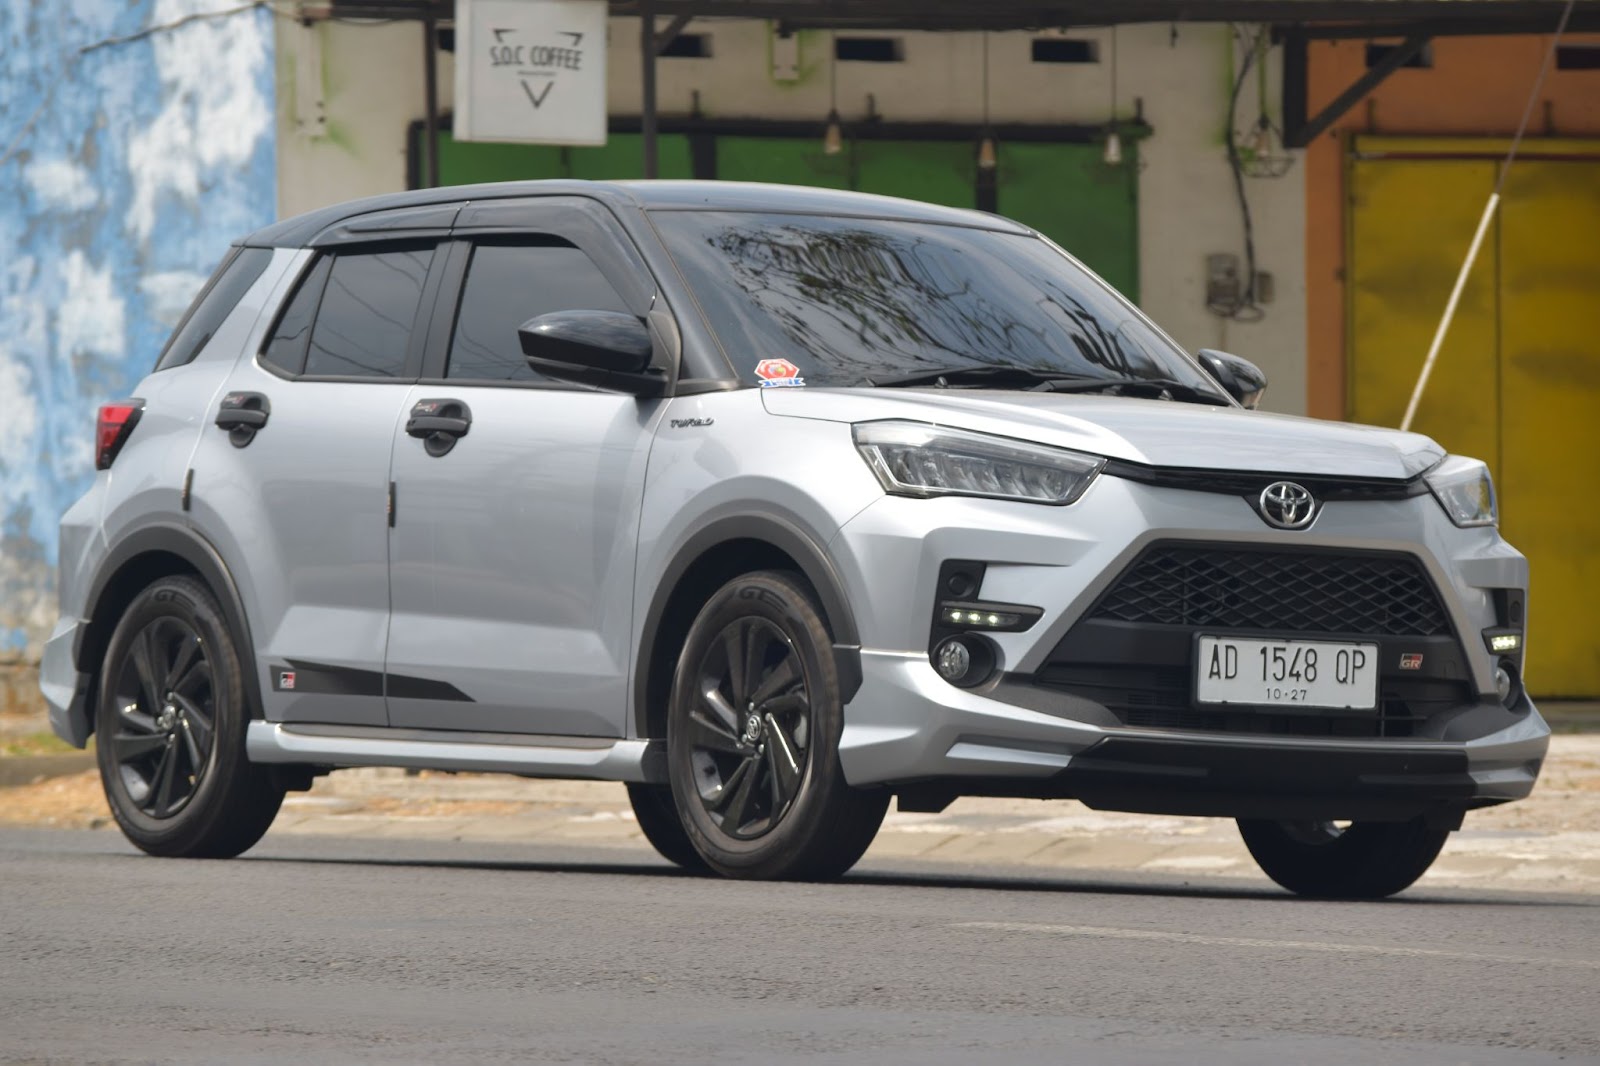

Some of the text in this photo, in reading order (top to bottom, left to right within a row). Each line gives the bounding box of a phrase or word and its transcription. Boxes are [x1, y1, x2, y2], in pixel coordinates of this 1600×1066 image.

[530, 46, 583, 70] COFFEE
[1208, 644, 1366, 685] AD 1548 QP
[1400, 658, 1421, 669] GR
